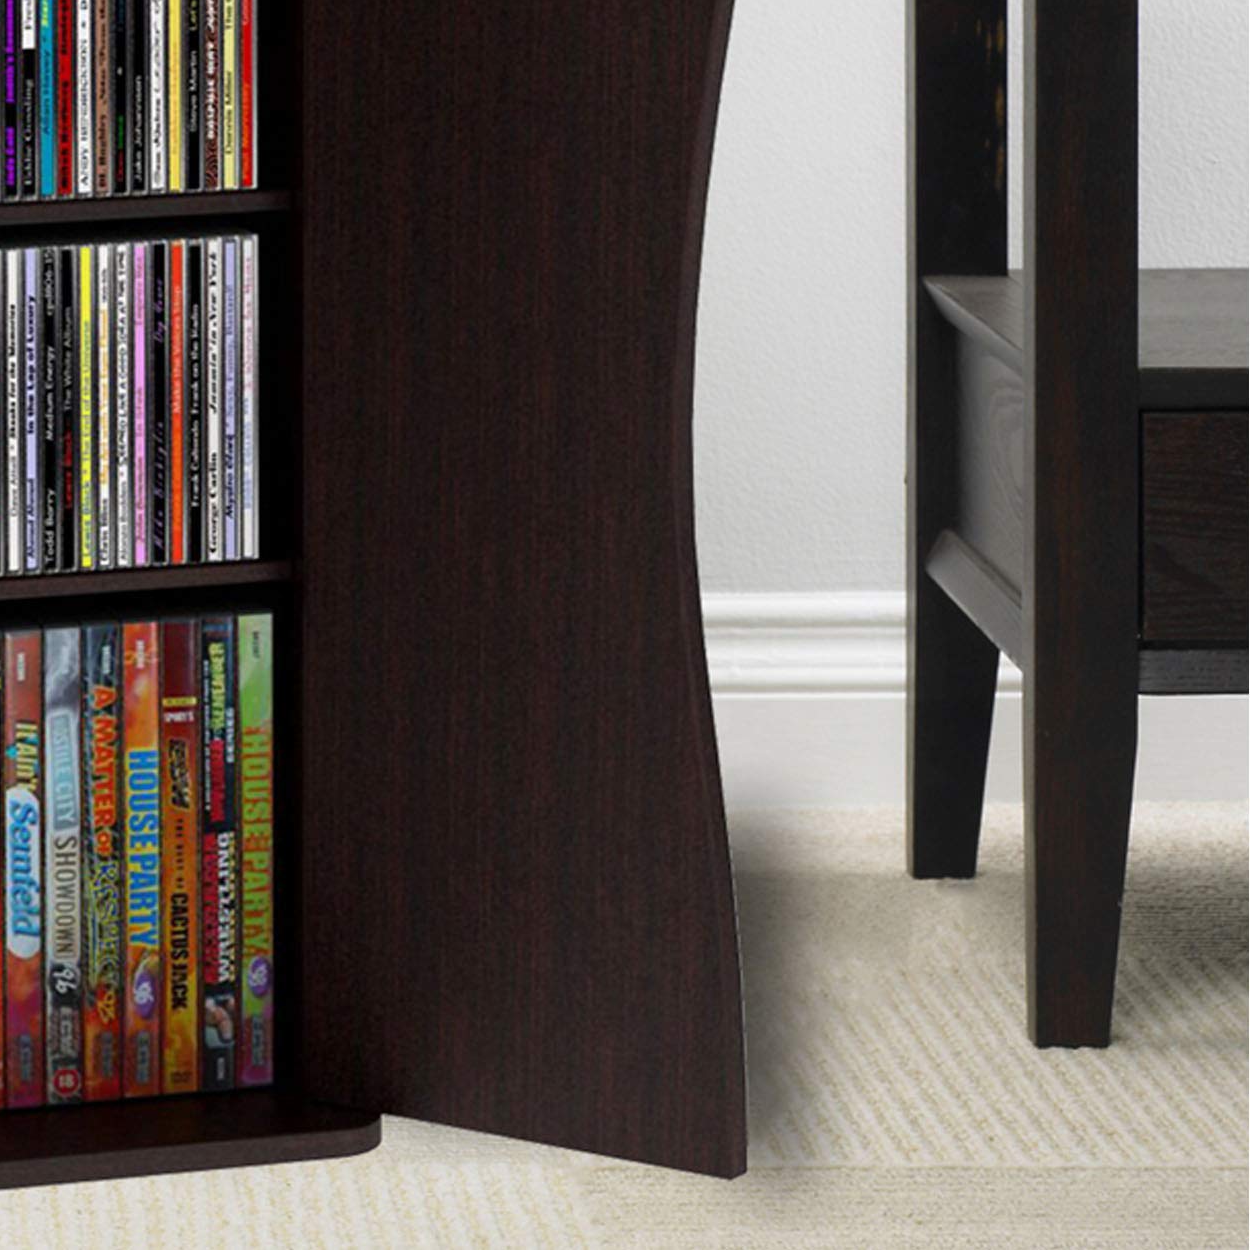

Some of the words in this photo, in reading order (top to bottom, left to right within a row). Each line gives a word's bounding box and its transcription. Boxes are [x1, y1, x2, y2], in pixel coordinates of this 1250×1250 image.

[187, 1, 198, 31] Let's
[223, 7, 233, 31] The
[187, 50, 198, 92] Martin
[223, 71, 233, 106] Miller
[187, 95, 198, 132] Steve
[223, 109, 233, 155] Dennis
[207, 253, 217, 287] York
[26, 295, 36, 344] Luxury
[207, 293, 217, 325] New
[26, 348, 36, 363] of
[26, 364, 36, 391] Lap
[45, 346, 56, 390] Energy
[26, 394, 36, 417] the
[26, 419, 36, 435] In
[45, 393, 56, 441] Medium
[208, 453, 218, 498] Carlin
[225, 474, 235, 519] Mystro
[46, 487, 56, 528] Barry
[208, 503, 218, 553] George
[45, 530, 55, 562] Todd
[89, 684, 117, 708] A
[225, 707, 236, 763] SERIES
[91, 713, 118, 827] MATTER
[242, 730, 271, 832] HOUSE
[55, 781, 75, 822] CITY
[128, 748, 160, 848] HOUSE
[53, 834, 81, 959] SHOWDOWN
[128, 849, 160, 949] PARTY
[217, 833, 230, 983] WRESTLING
[242, 848, 271, 958] PARTY
[171, 891, 189, 961] CACTUS
[171, 962, 189, 1011] JACK
